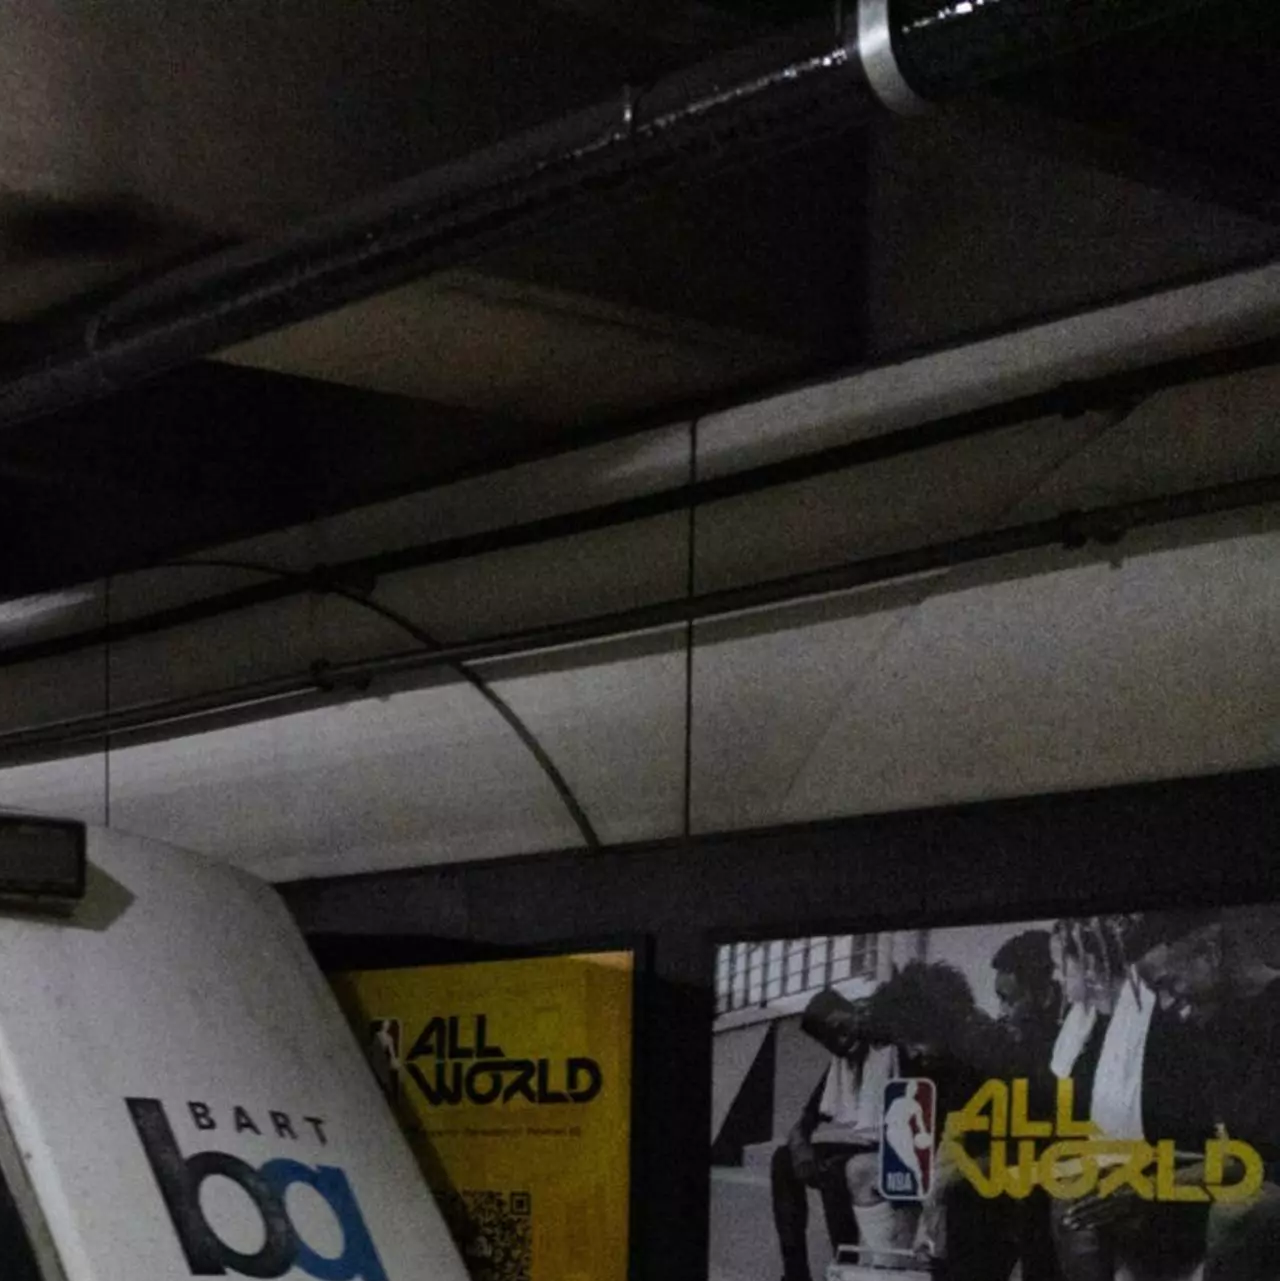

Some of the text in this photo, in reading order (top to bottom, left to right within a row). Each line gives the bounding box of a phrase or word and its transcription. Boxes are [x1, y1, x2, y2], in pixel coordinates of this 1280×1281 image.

[406, 1015, 505, 1060] ALL
[406, 1058, 602, 1105] WORLD
[187, 1101, 328, 1145] BART
[945, 1077, 1104, 1138] ALL
[948, 1139, 1265, 1202] WORLD
